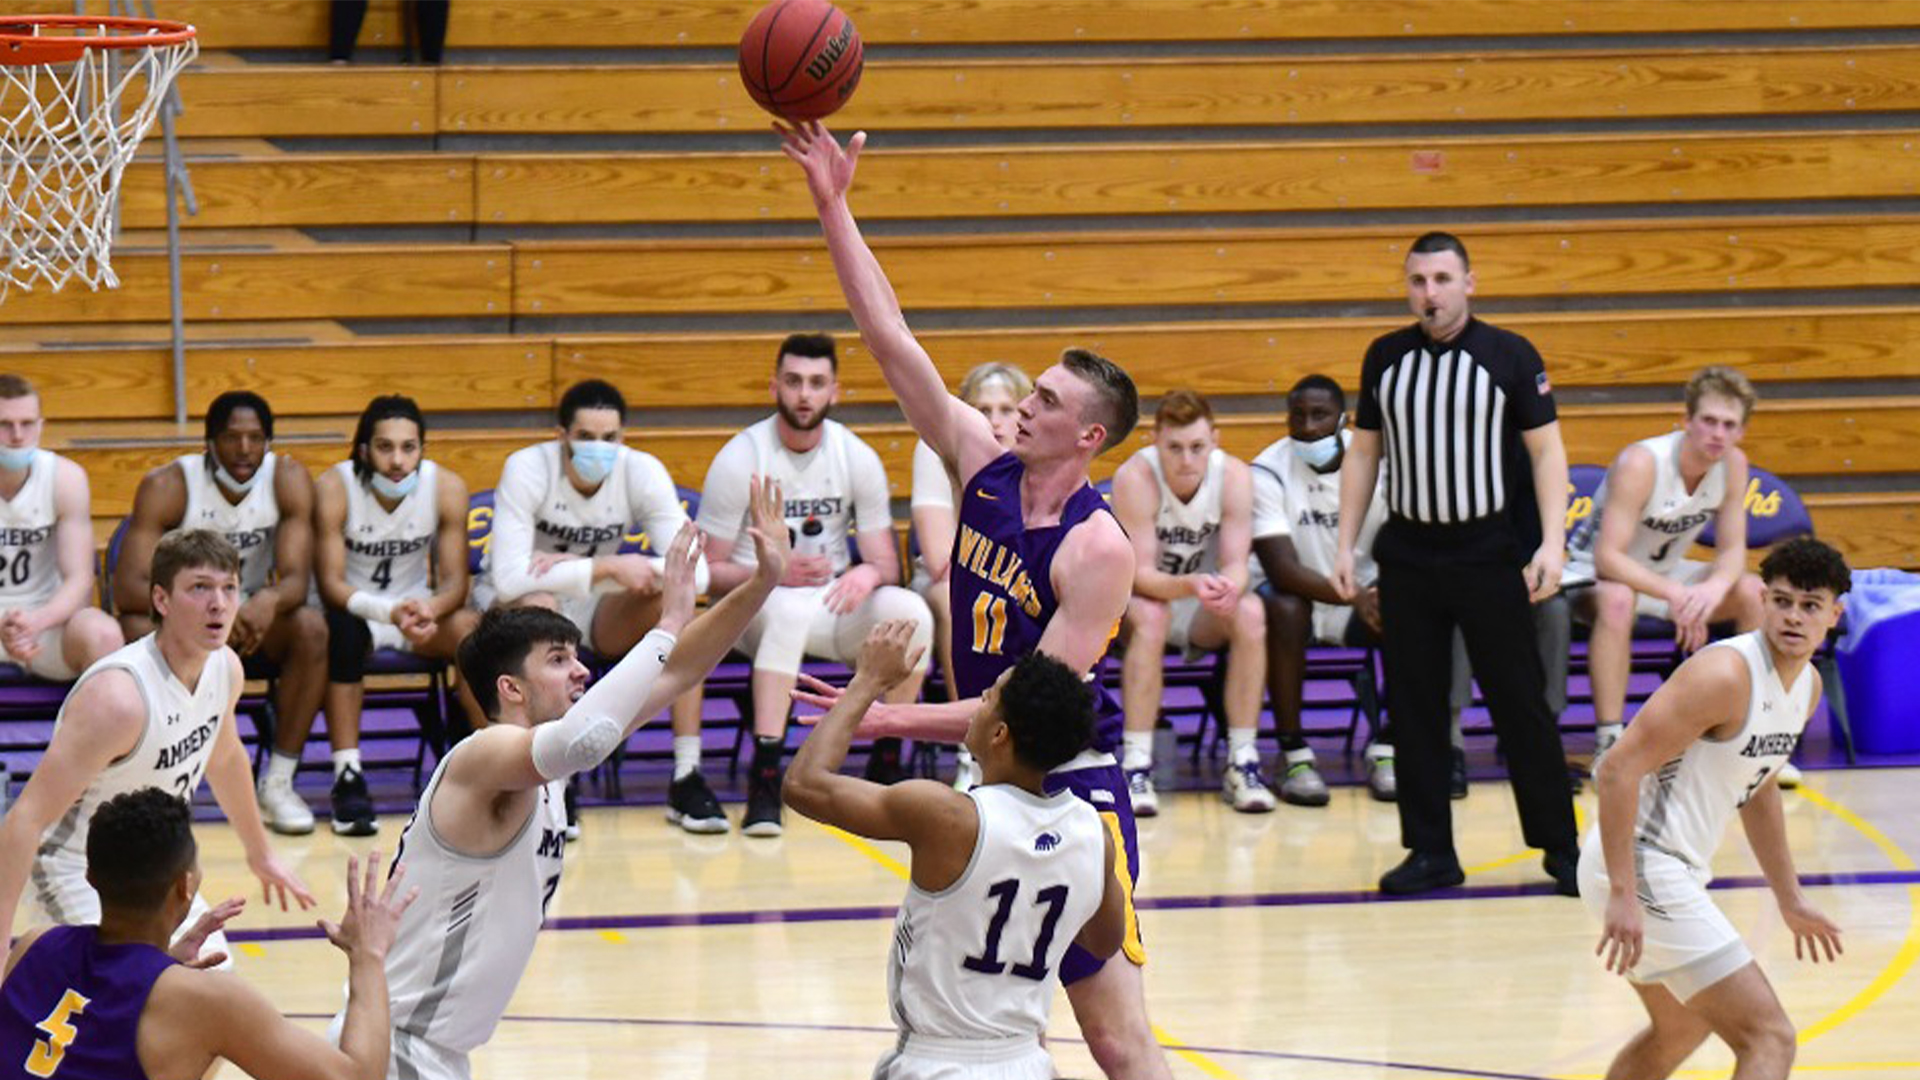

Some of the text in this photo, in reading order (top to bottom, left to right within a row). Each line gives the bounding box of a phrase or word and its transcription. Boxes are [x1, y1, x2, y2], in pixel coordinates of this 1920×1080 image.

[536, 520, 623, 543] AMHERST
[371, 557, 393, 590] 4
[1157, 550, 1204, 576] 30
[971, 590, 1008, 656] 11
[962, 878, 1069, 981] 11
[24, 987, 92, 1079] 5
